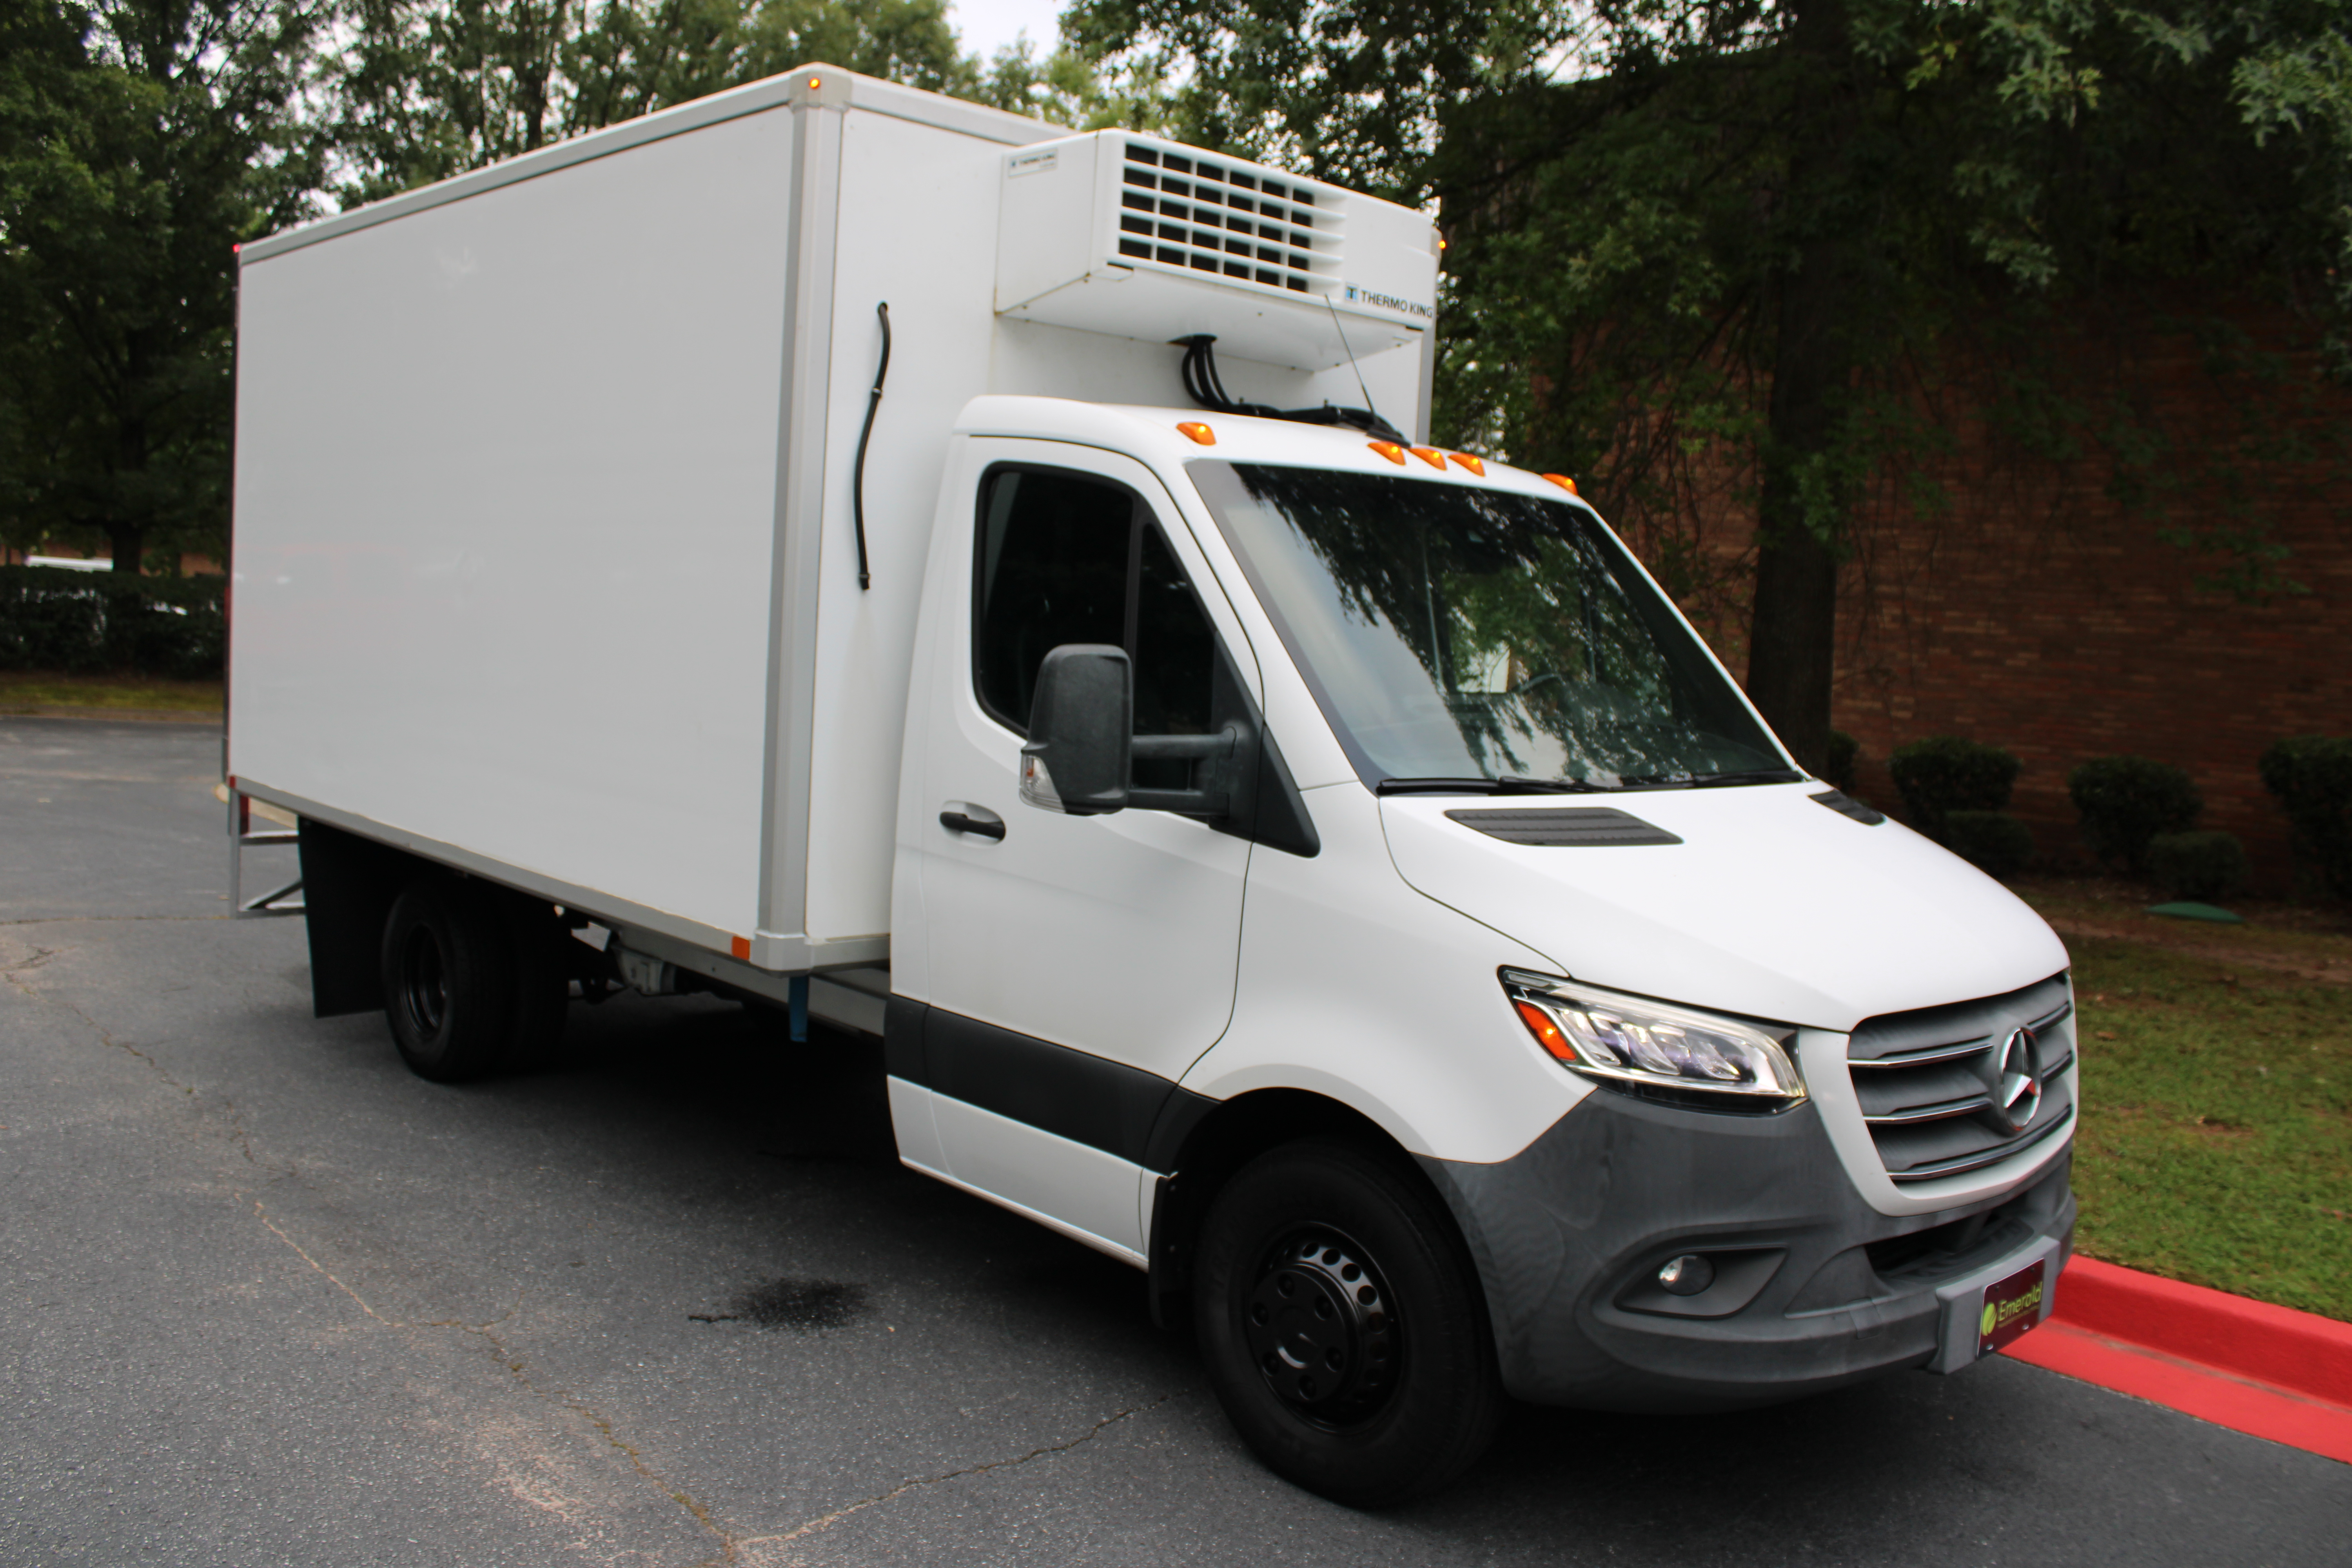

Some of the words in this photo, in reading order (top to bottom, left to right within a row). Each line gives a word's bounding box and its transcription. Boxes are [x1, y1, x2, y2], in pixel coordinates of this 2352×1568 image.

[1361, 289, 1408, 312] THERMO
[1410, 303, 1433, 318] KING
[1998, 1281, 2043, 1321] Emerald
